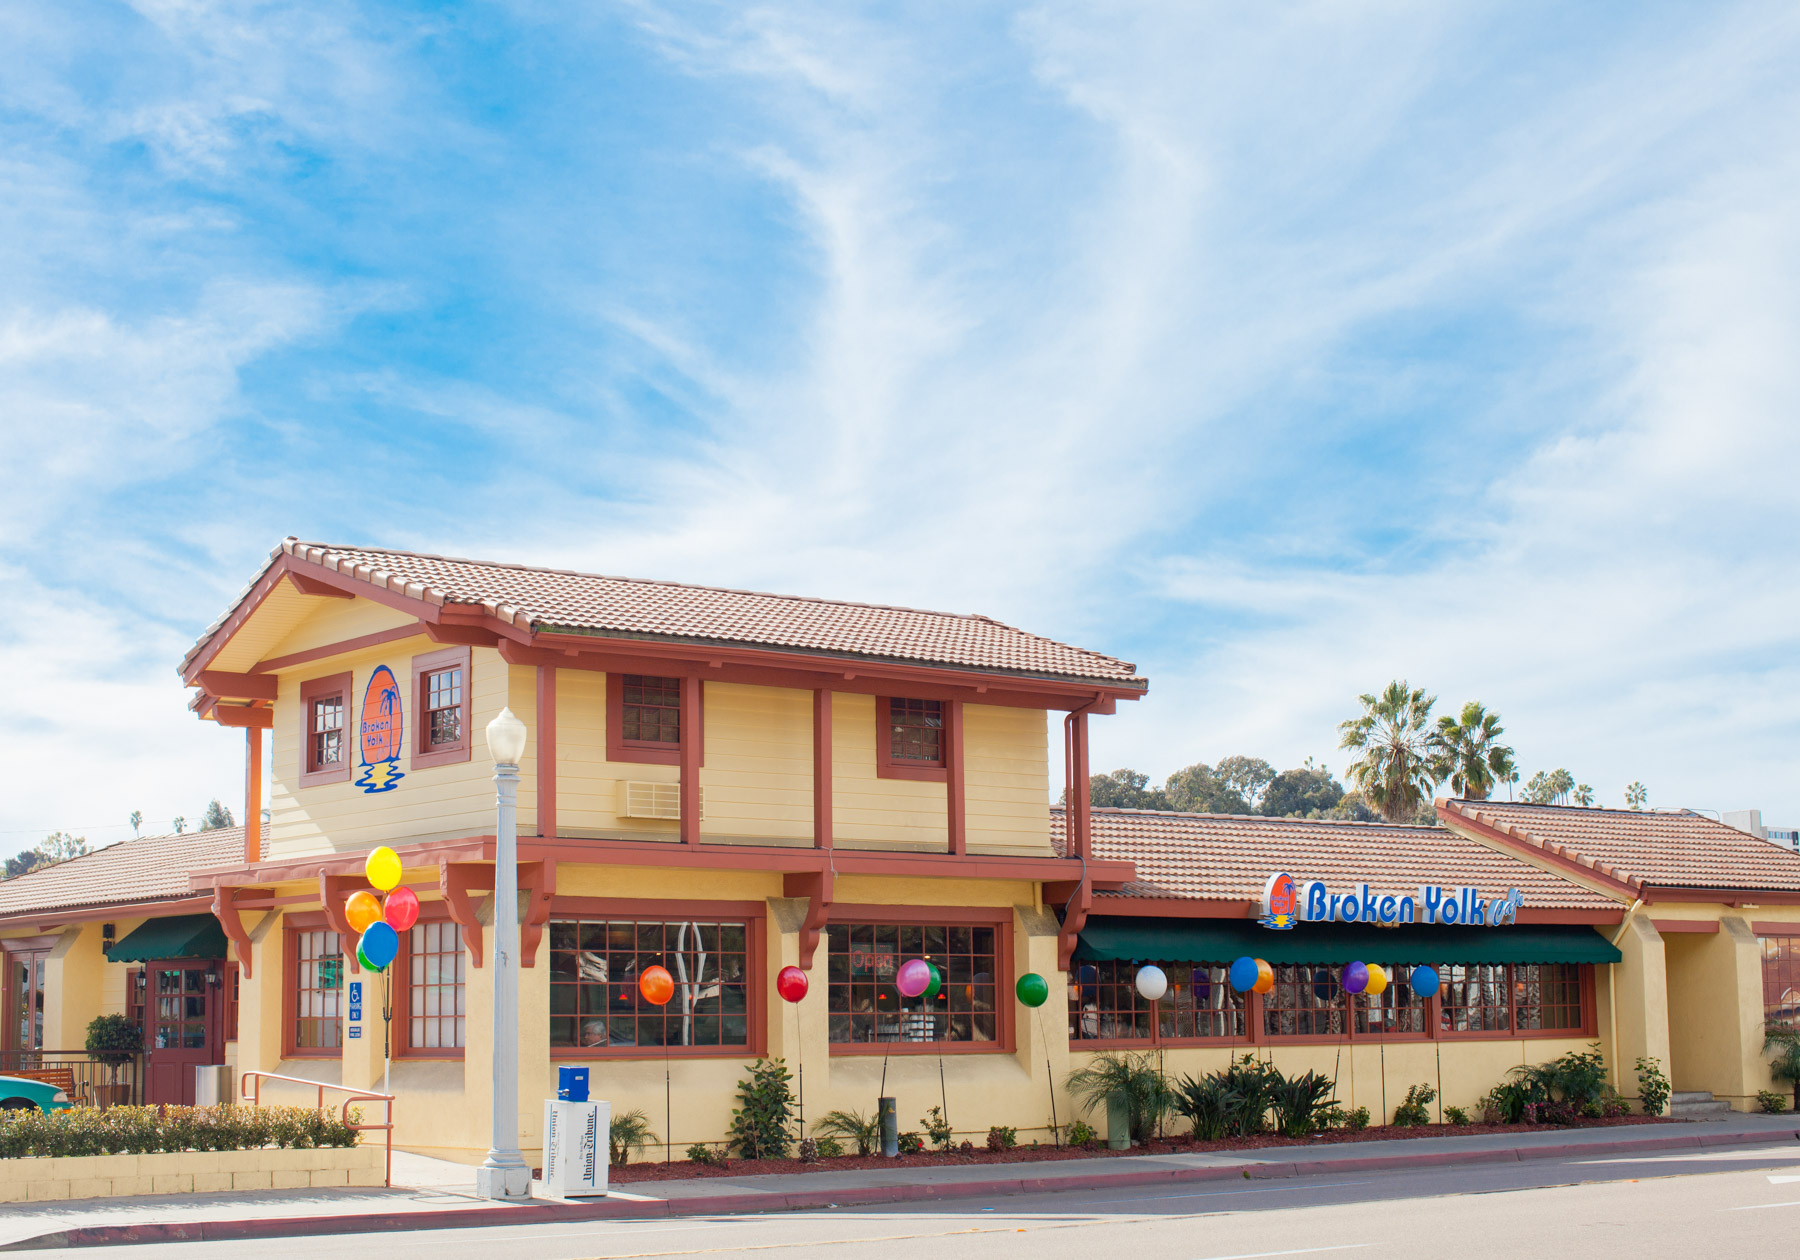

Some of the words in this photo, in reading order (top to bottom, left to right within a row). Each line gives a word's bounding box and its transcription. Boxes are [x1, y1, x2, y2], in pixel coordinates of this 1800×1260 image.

[362, 719, 389, 733] Broken
[367, 733, 383, 746] Yolk
[1306, 881, 1414, 923] Broken
[1425, 886, 1484, 925] Yolk
[852, 950, 893, 972] Open
